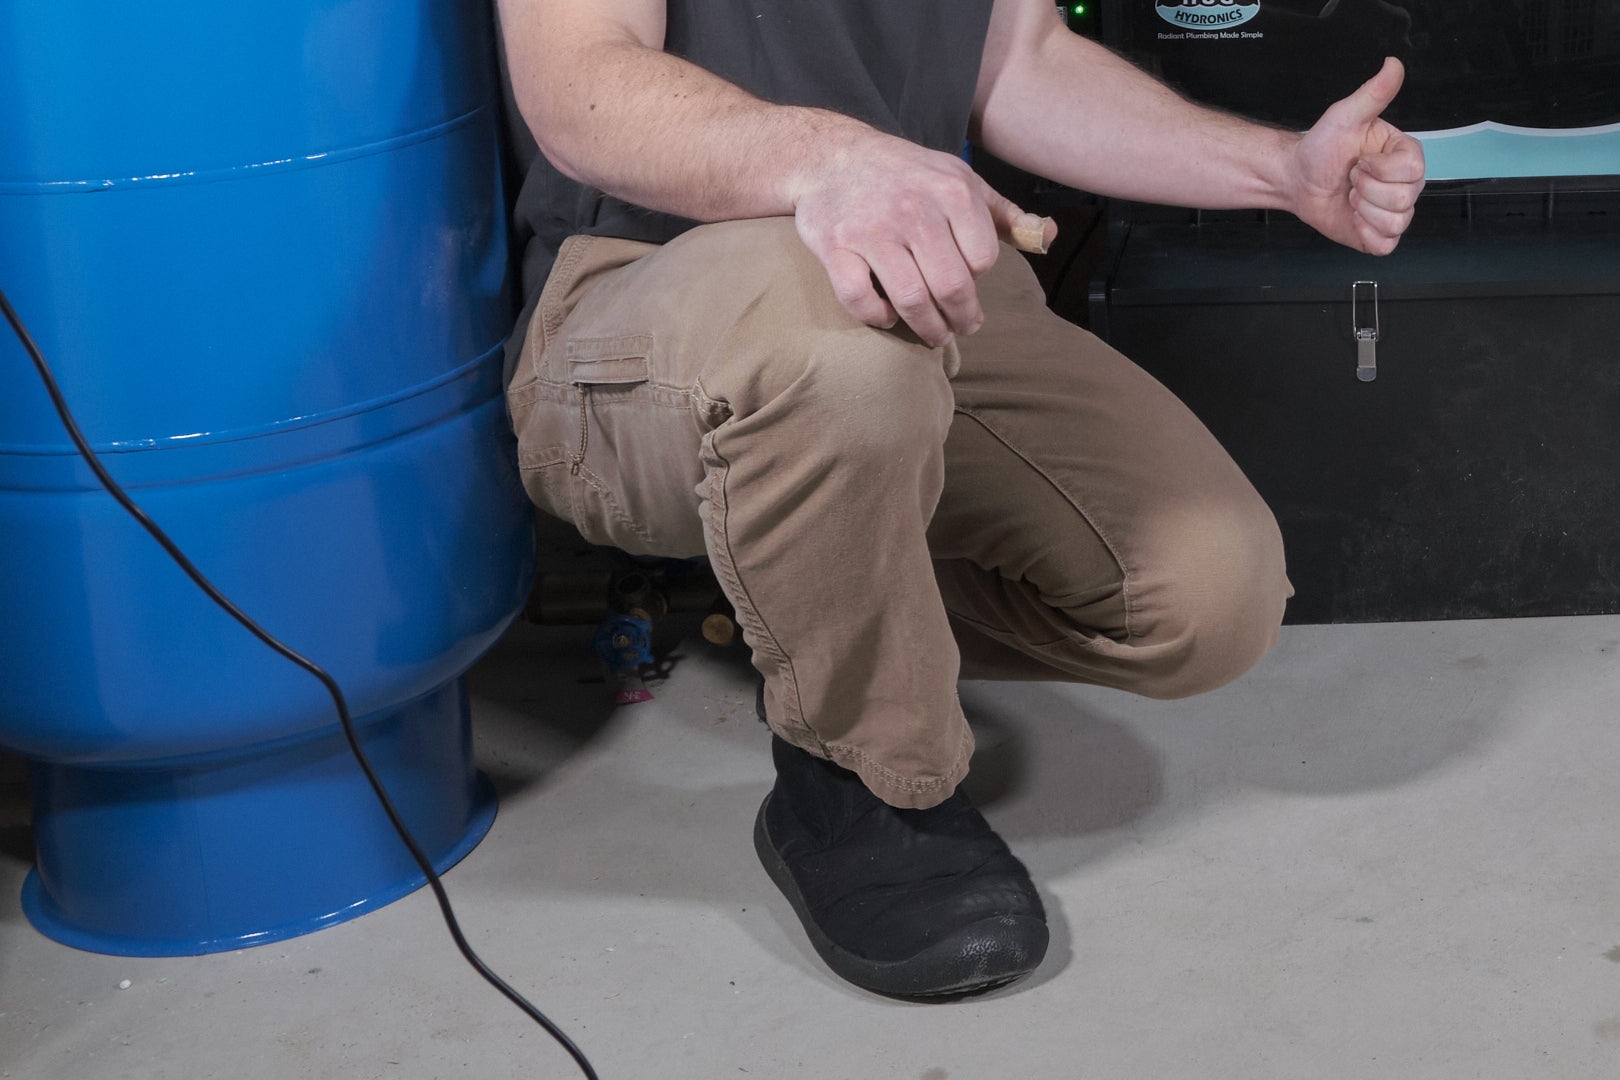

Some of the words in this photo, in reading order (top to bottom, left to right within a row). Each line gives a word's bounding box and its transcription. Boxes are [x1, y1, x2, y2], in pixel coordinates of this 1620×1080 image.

[1174, 8, 1243, 24] HYDRONICS
[1157, 32, 1185, 40] Radiant
[1186, 32, 1219, 40] Plumbing
[1220, 31, 1240, 39] Made
[1240, 31, 1263, 40] Simple
